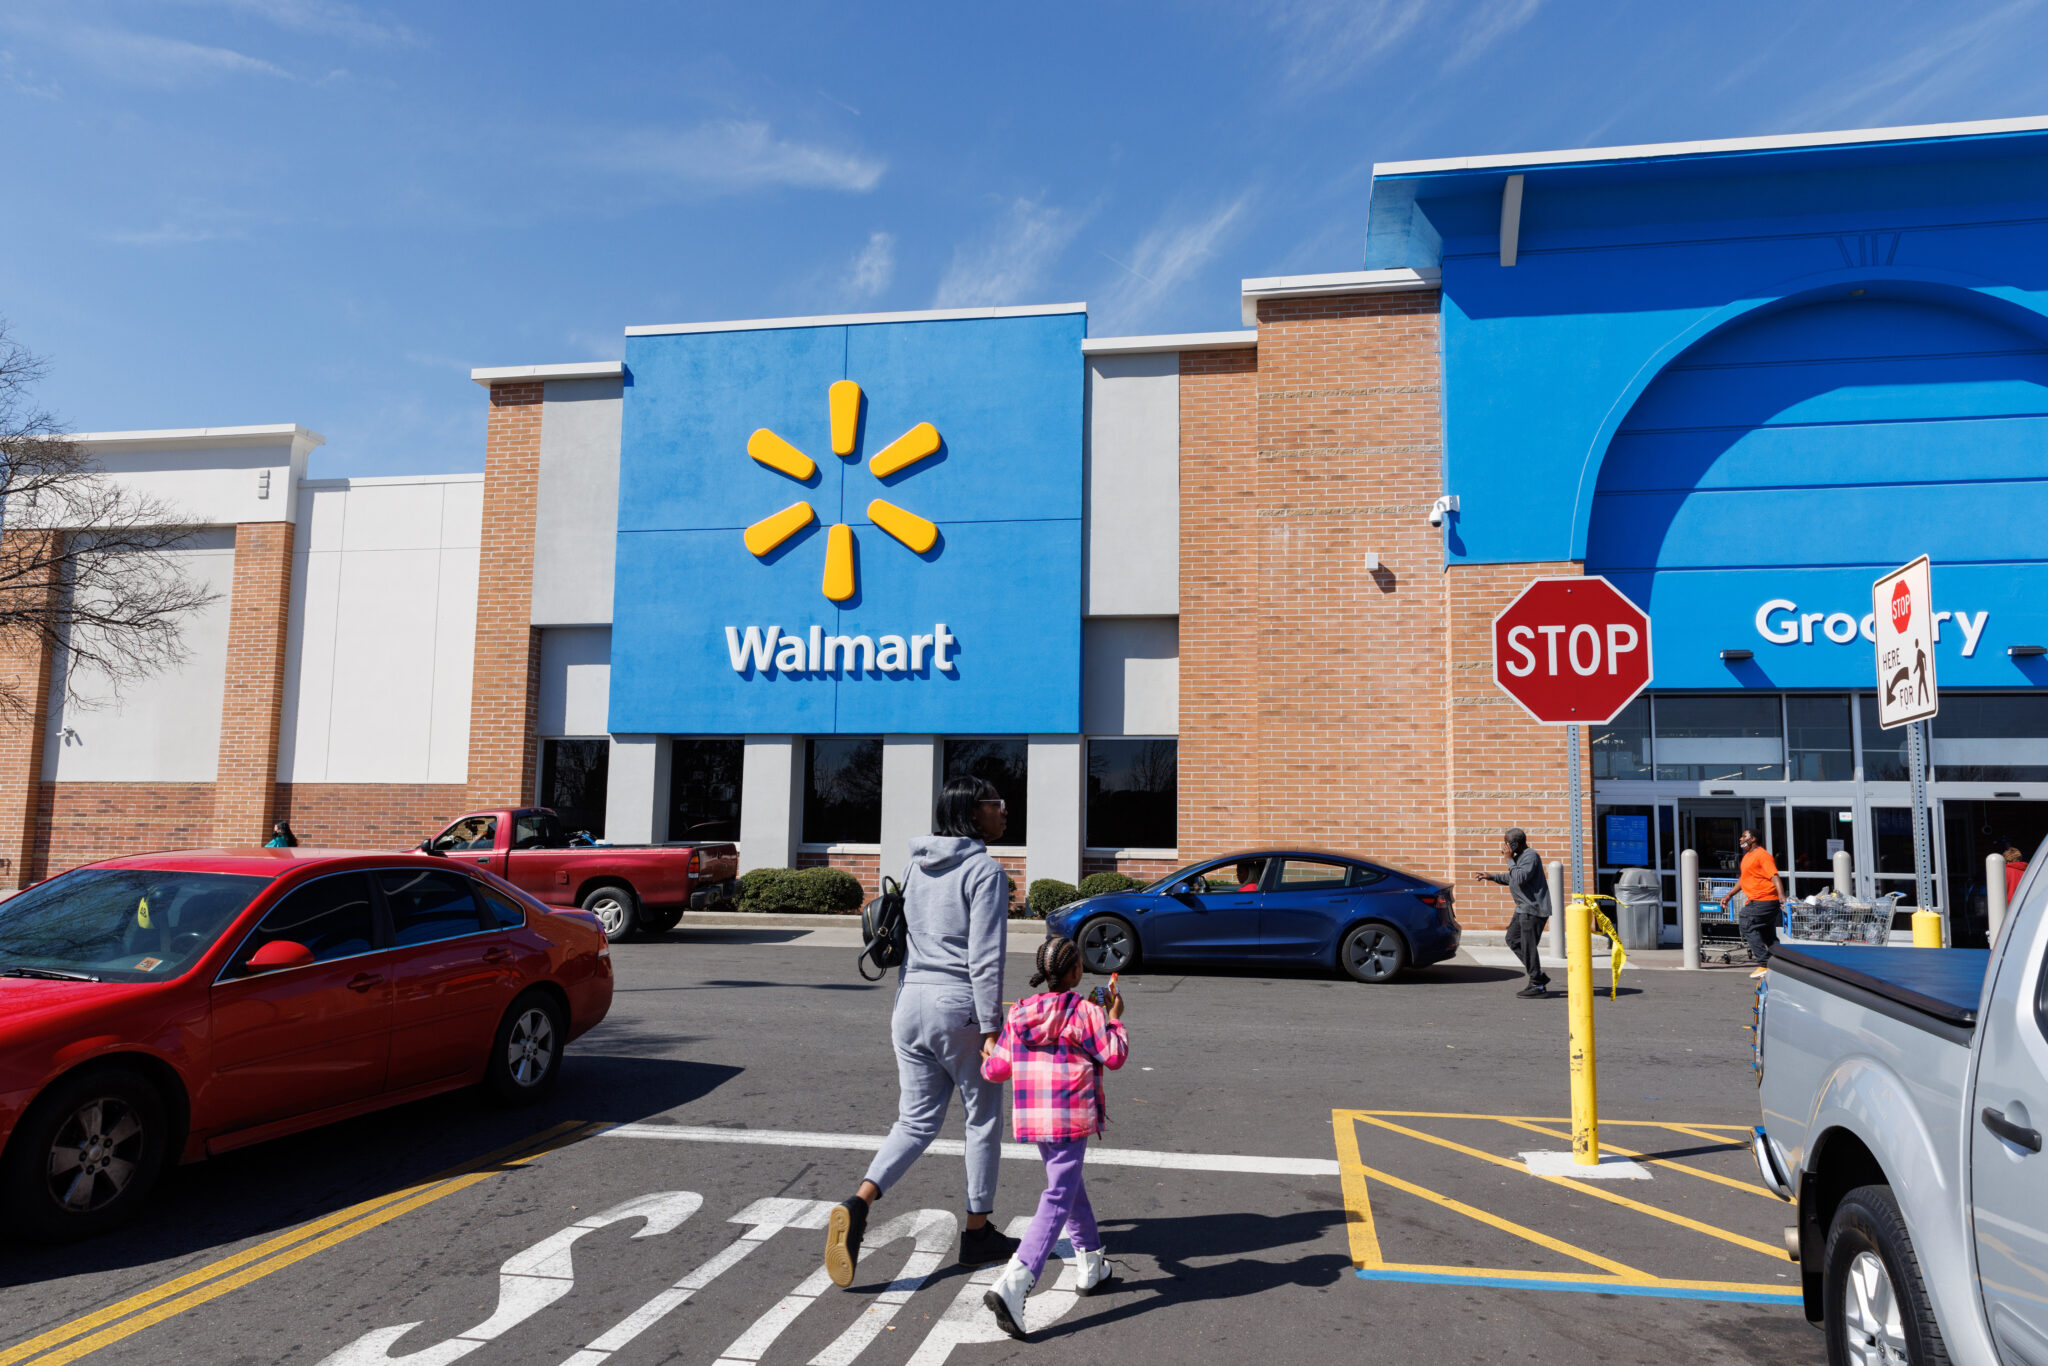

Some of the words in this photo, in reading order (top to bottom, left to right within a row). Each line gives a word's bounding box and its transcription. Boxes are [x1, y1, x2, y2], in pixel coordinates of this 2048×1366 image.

[1756, 599, 1988, 656] Grocry
[1892, 594, 1911, 620] STOP
[725, 623, 954, 672] Walmart
[1506, 623, 1639, 678] STOP
[1882, 647, 1901, 671] HERE
[1899, 685, 1914, 707] FOR
[313, 1190, 1081, 1366] STOP
